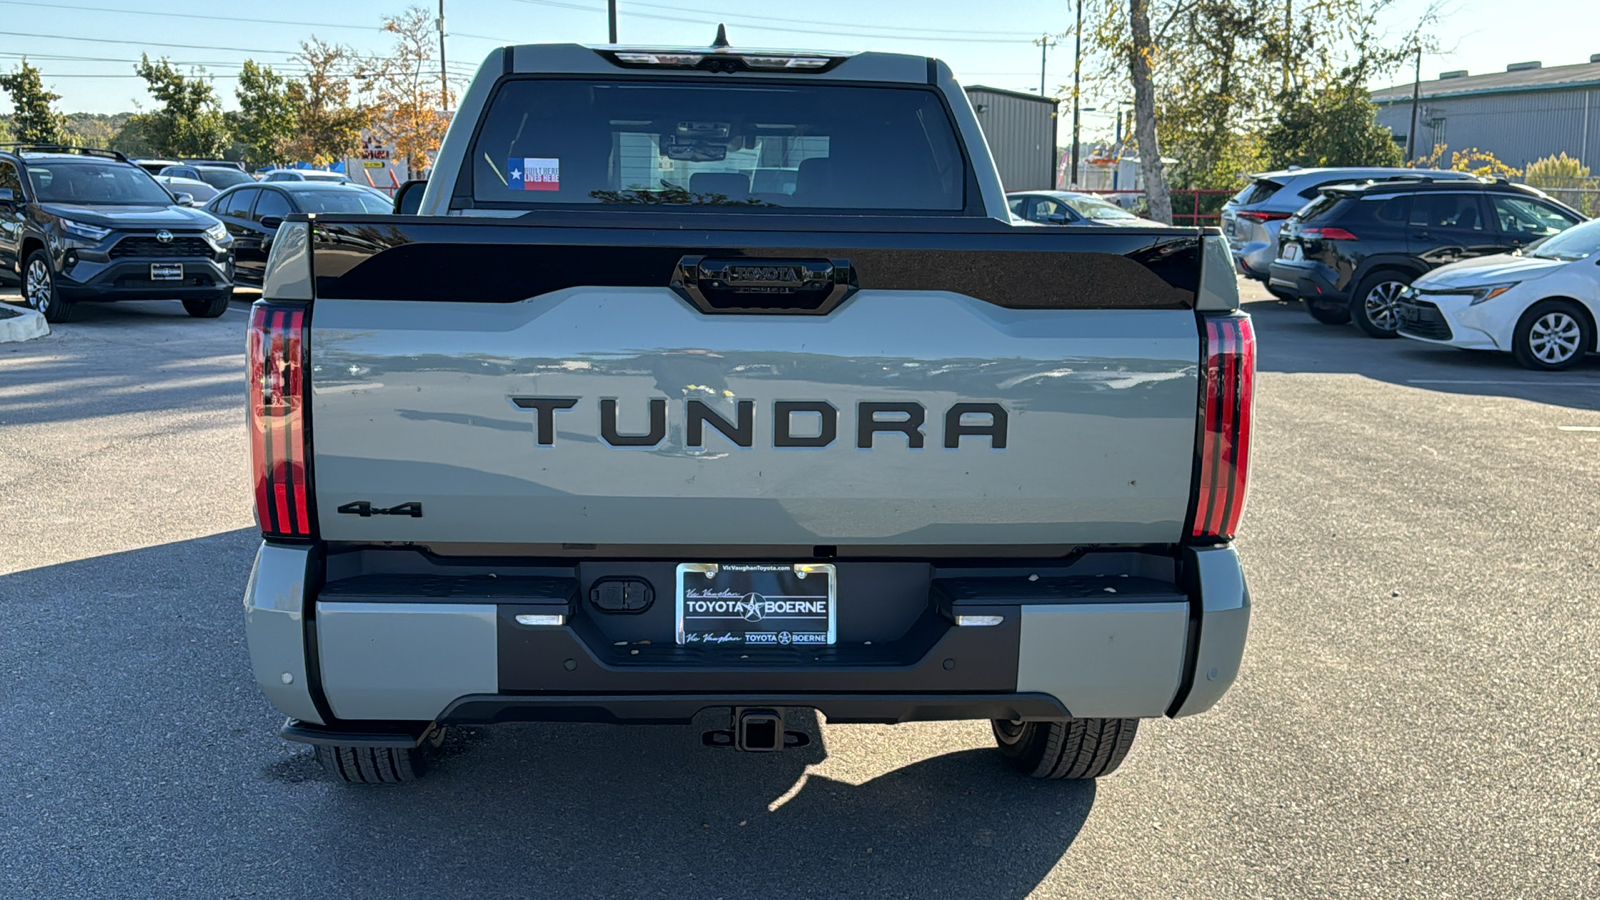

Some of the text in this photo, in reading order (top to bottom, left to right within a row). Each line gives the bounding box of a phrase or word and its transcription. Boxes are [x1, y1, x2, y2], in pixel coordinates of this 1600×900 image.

[524, 167, 559, 175] BUILT HERE
[524, 174, 559, 182] LIVES HERE
[735, 267, 800, 281] TOYOTA
[512, 398, 1009, 449] TUNDRA
[685, 588, 741, 598] Vic Vaughan
[686, 601, 743, 613] TOYOTA
[765, 601, 827, 613] BOERNE
[685, 632, 827, 644] Vic Vaughan TOYOTA BOERNE
